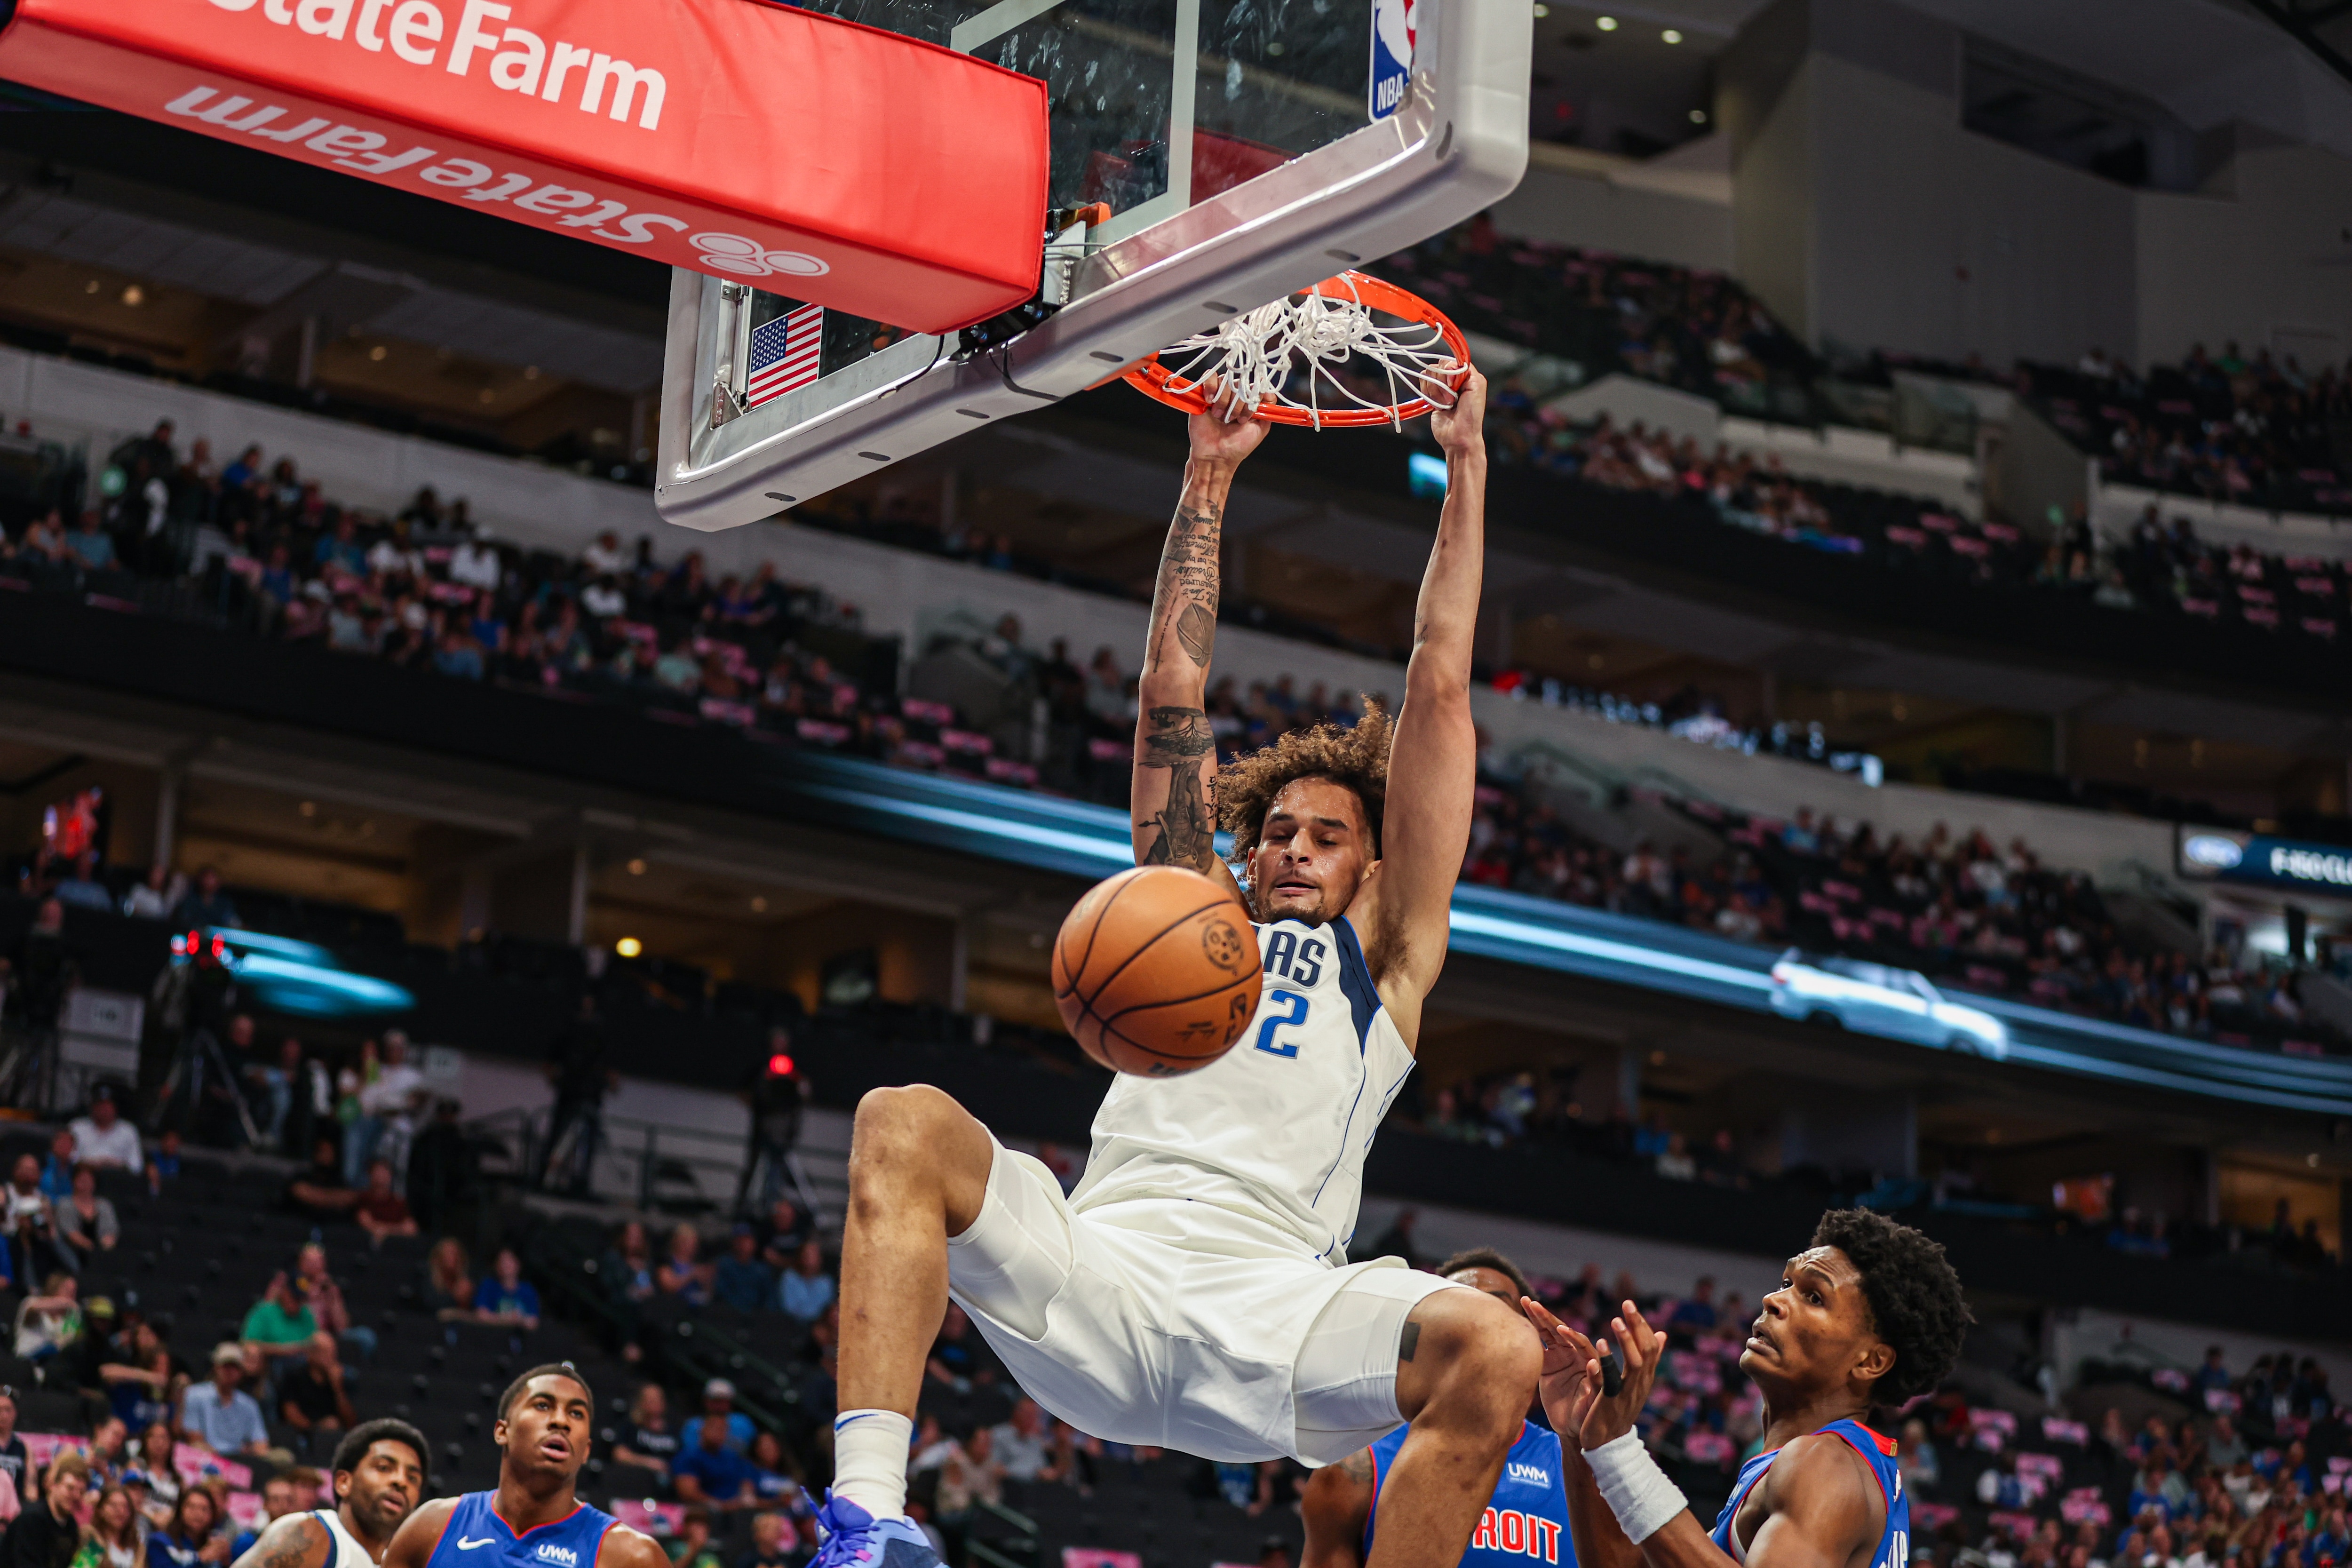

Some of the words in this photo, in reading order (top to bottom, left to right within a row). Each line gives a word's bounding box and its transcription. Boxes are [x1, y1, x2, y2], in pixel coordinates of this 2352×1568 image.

[1377, 72, 1404, 112] NBA
[1254, 989, 1310, 1059] 2
[1508, 1462, 1549, 1483] UWM
[538, 1544, 577, 1566] UWM
